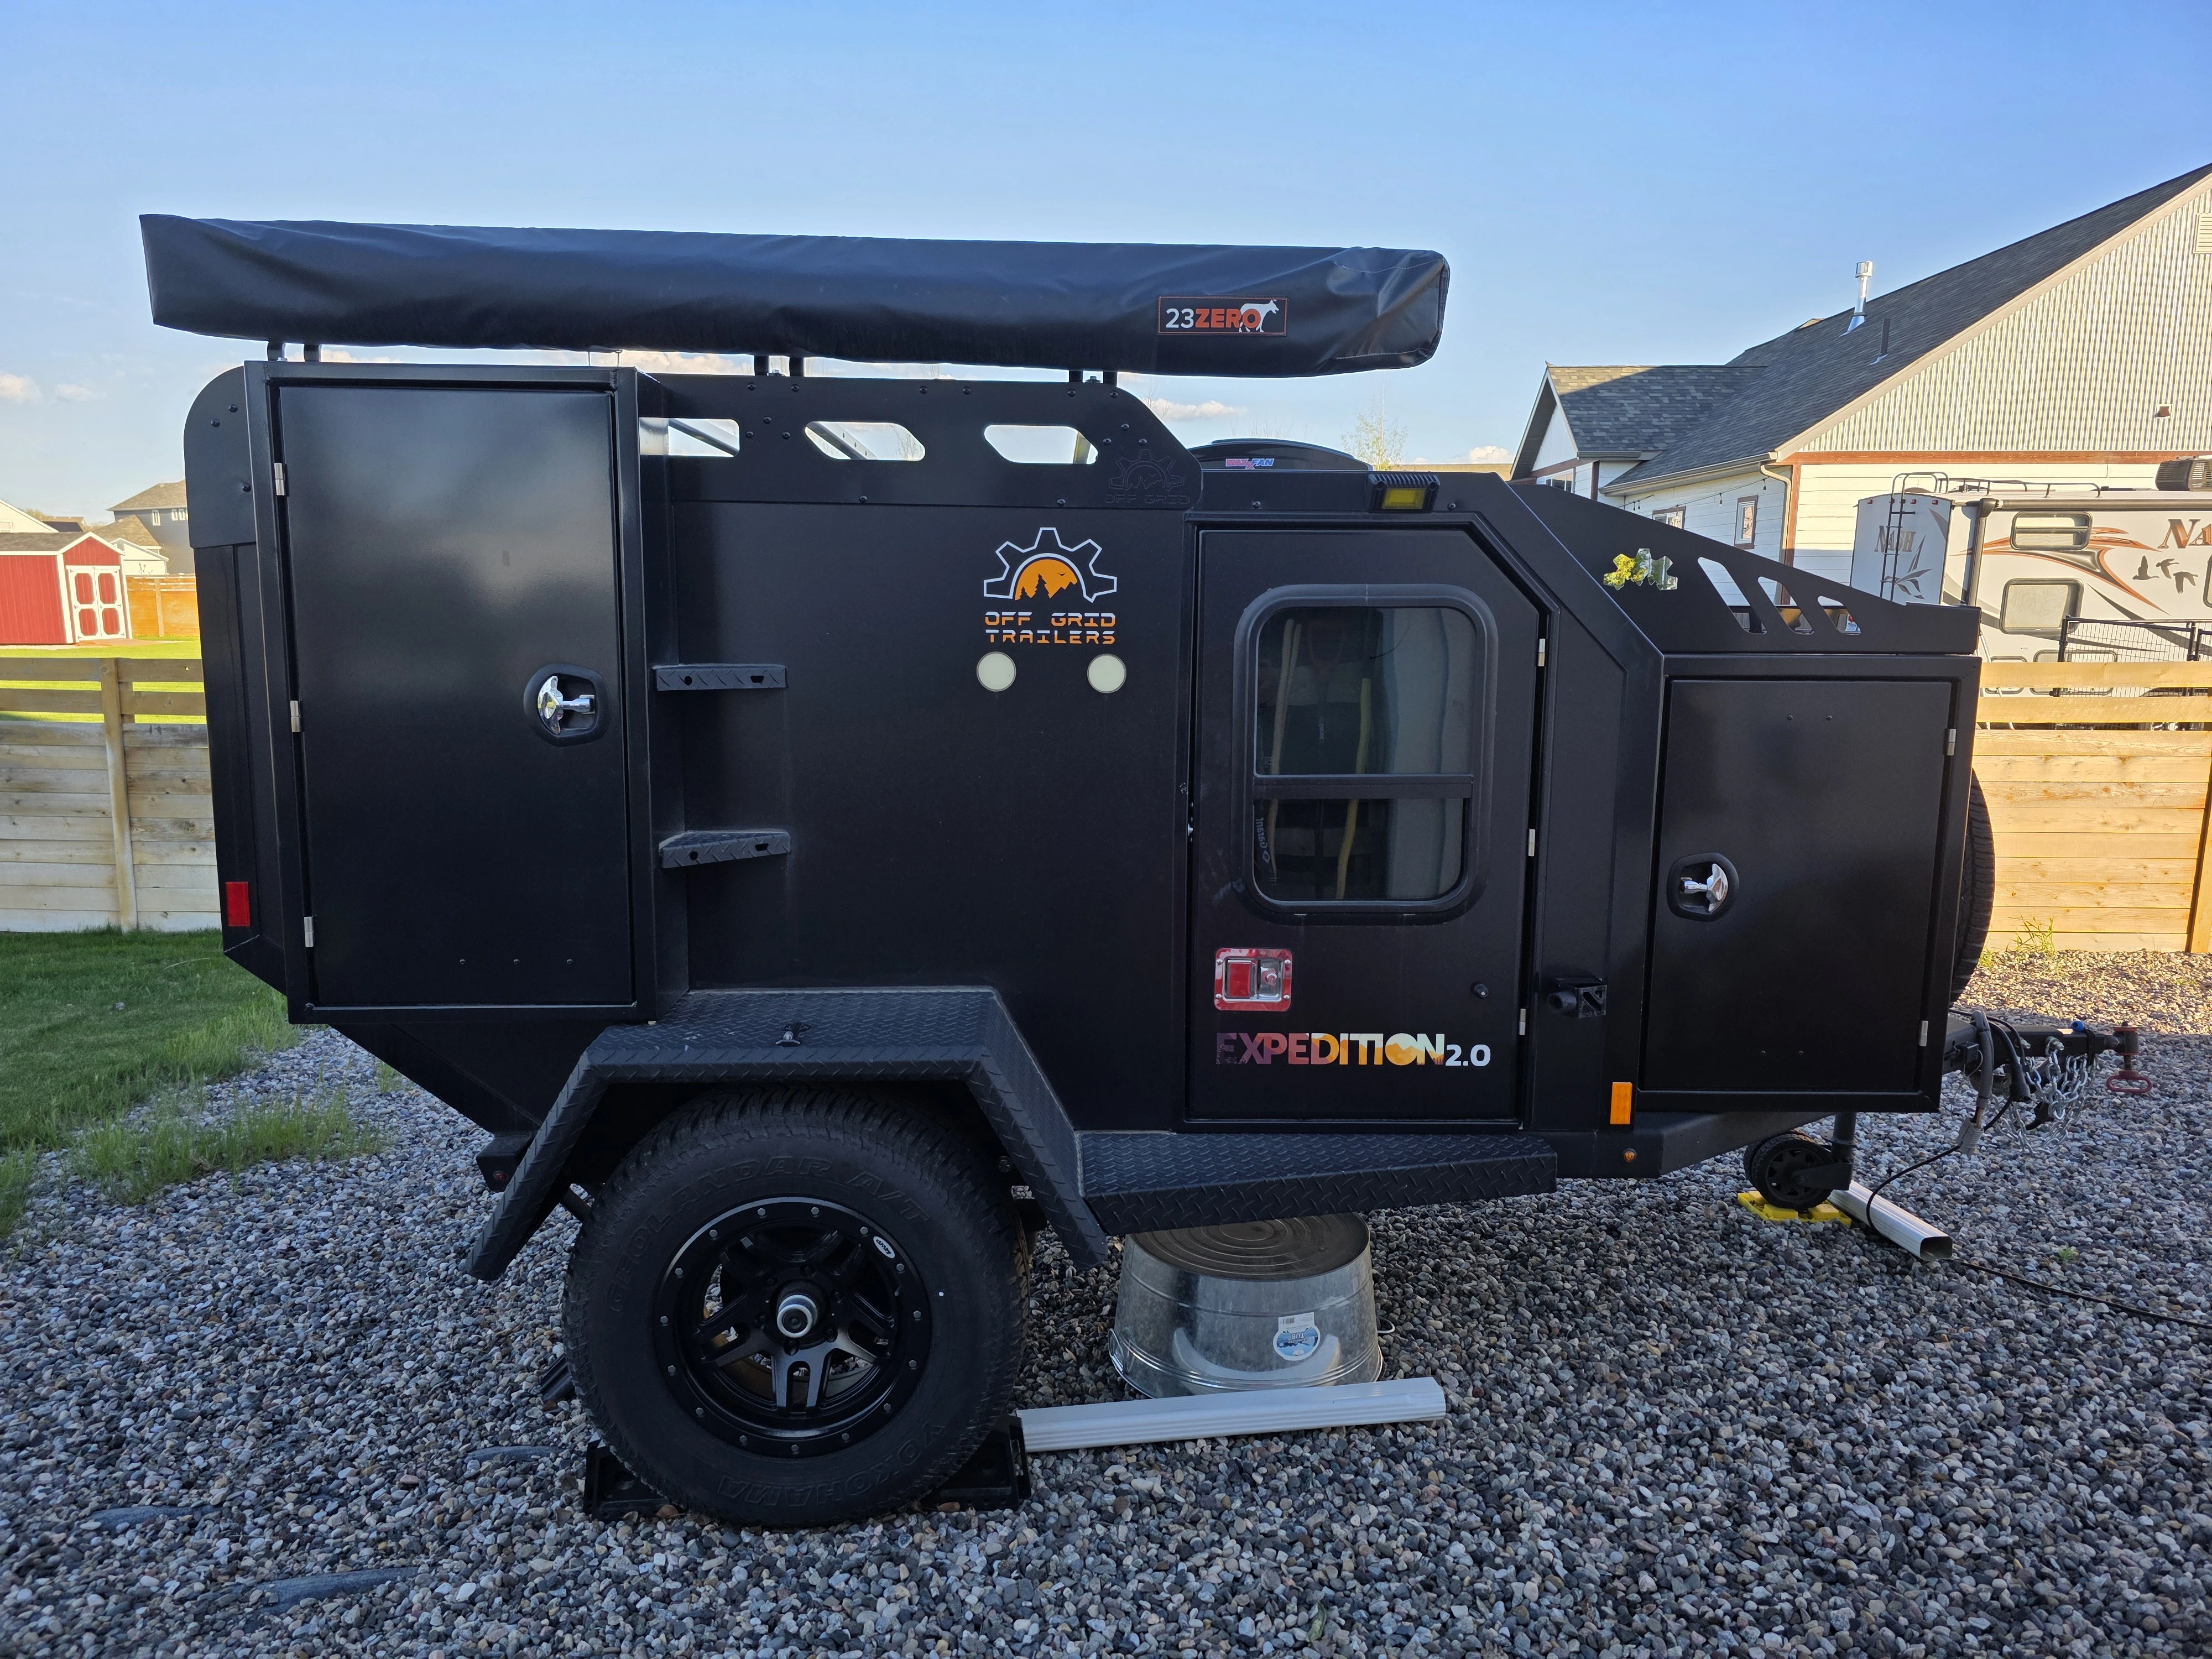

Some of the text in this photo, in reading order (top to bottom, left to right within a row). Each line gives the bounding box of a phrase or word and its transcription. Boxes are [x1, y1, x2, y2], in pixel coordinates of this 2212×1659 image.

[1166, 308, 1261, 328] 23ZERO
[1226, 458, 1275, 469] MAXXFAN
[985, 611, 1116, 627] OFF GRID
[985, 629, 1115, 644] TRAILERS
[1216, 1032, 1491, 1066] EXPEDITION 2.0
[846, 1171, 930, 1221] A/T
